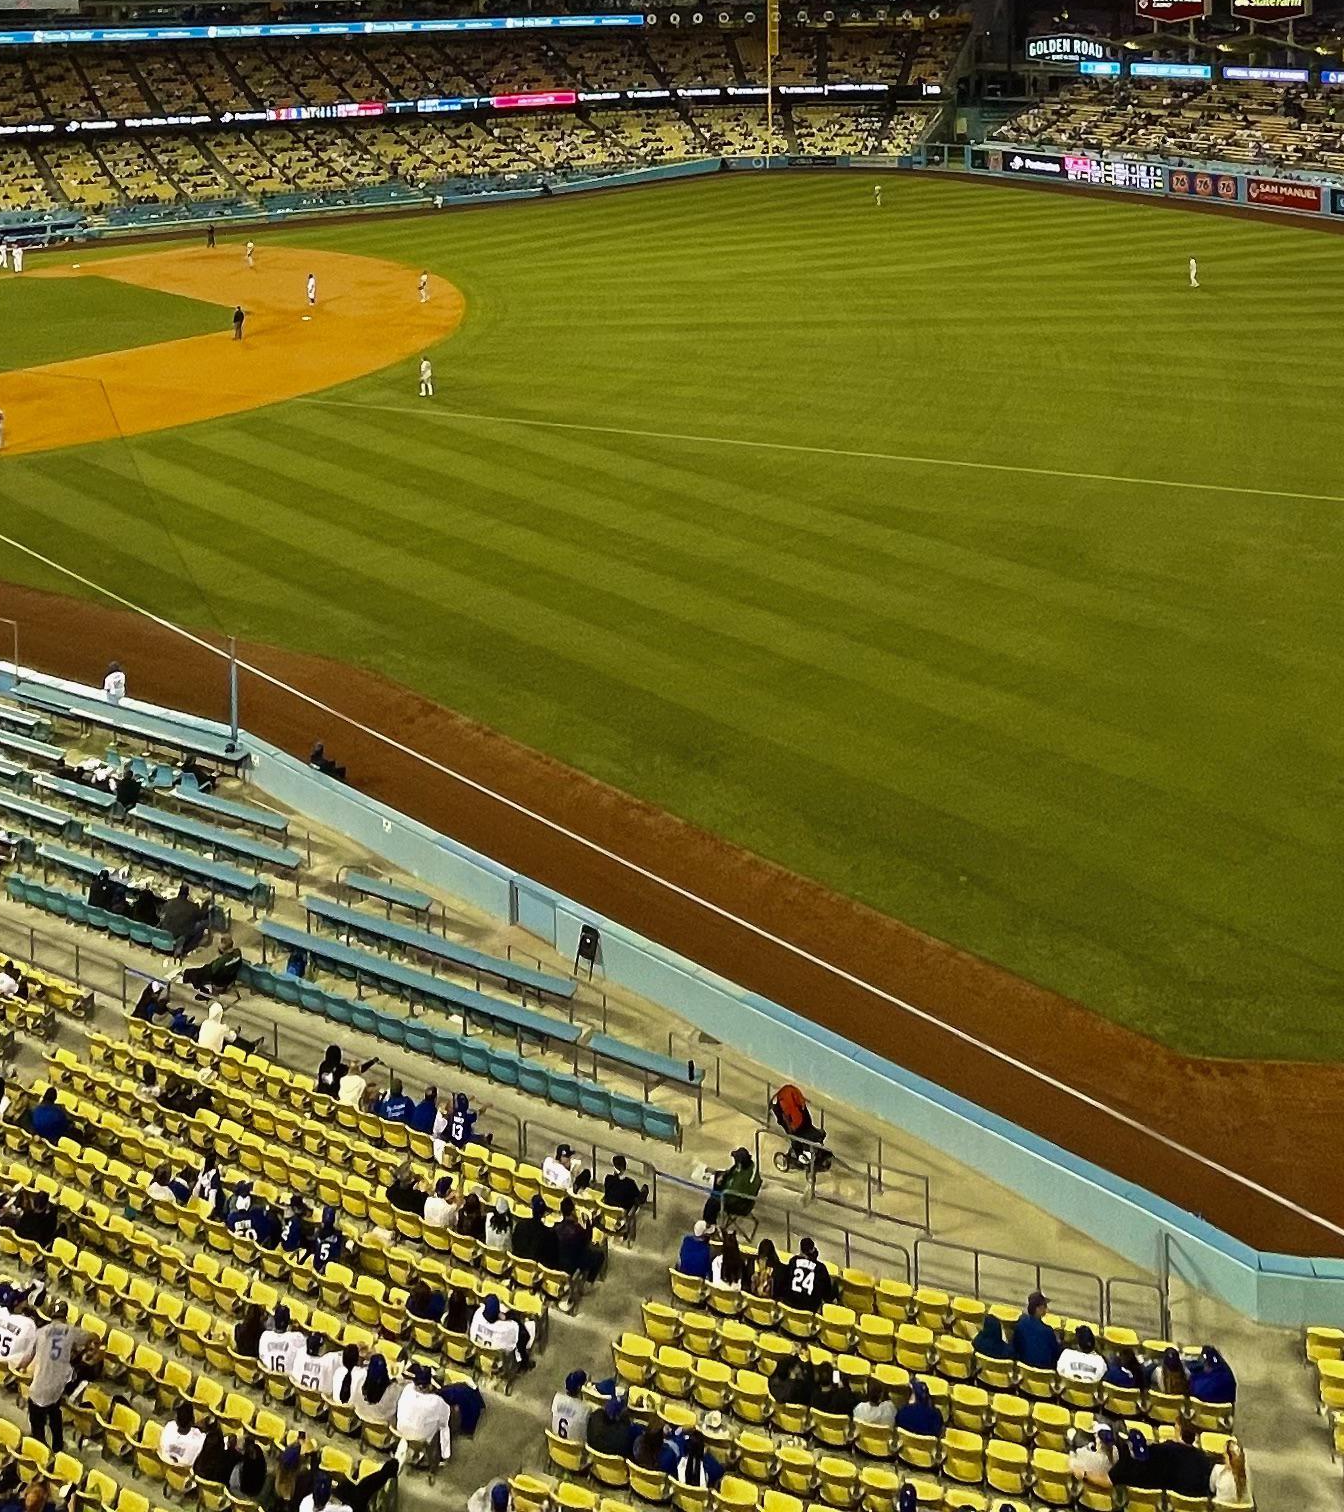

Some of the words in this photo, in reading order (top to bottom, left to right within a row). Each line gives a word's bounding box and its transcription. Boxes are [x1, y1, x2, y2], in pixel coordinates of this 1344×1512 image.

[1029, 38, 1071, 57] GOLDEN
[1073, 39, 1103, 59] ROAD
[1172, 176, 1188, 187] 76
[1196, 179, 1211, 190] 76
[1218, 182, 1234, 193] 76
[1259, 183, 1278, 194] SAN
[1279, 185, 1318, 200] MANUEL
[451, 1124, 464, 1140] 13
[320, 1243, 331, 1261] 5
[792, 1270, 815, 1295] 24
[50, 1335, 63, 1361] 5
[270, 1355, 285, 1373] 16
[557, 1418, 570, 1439] 6
